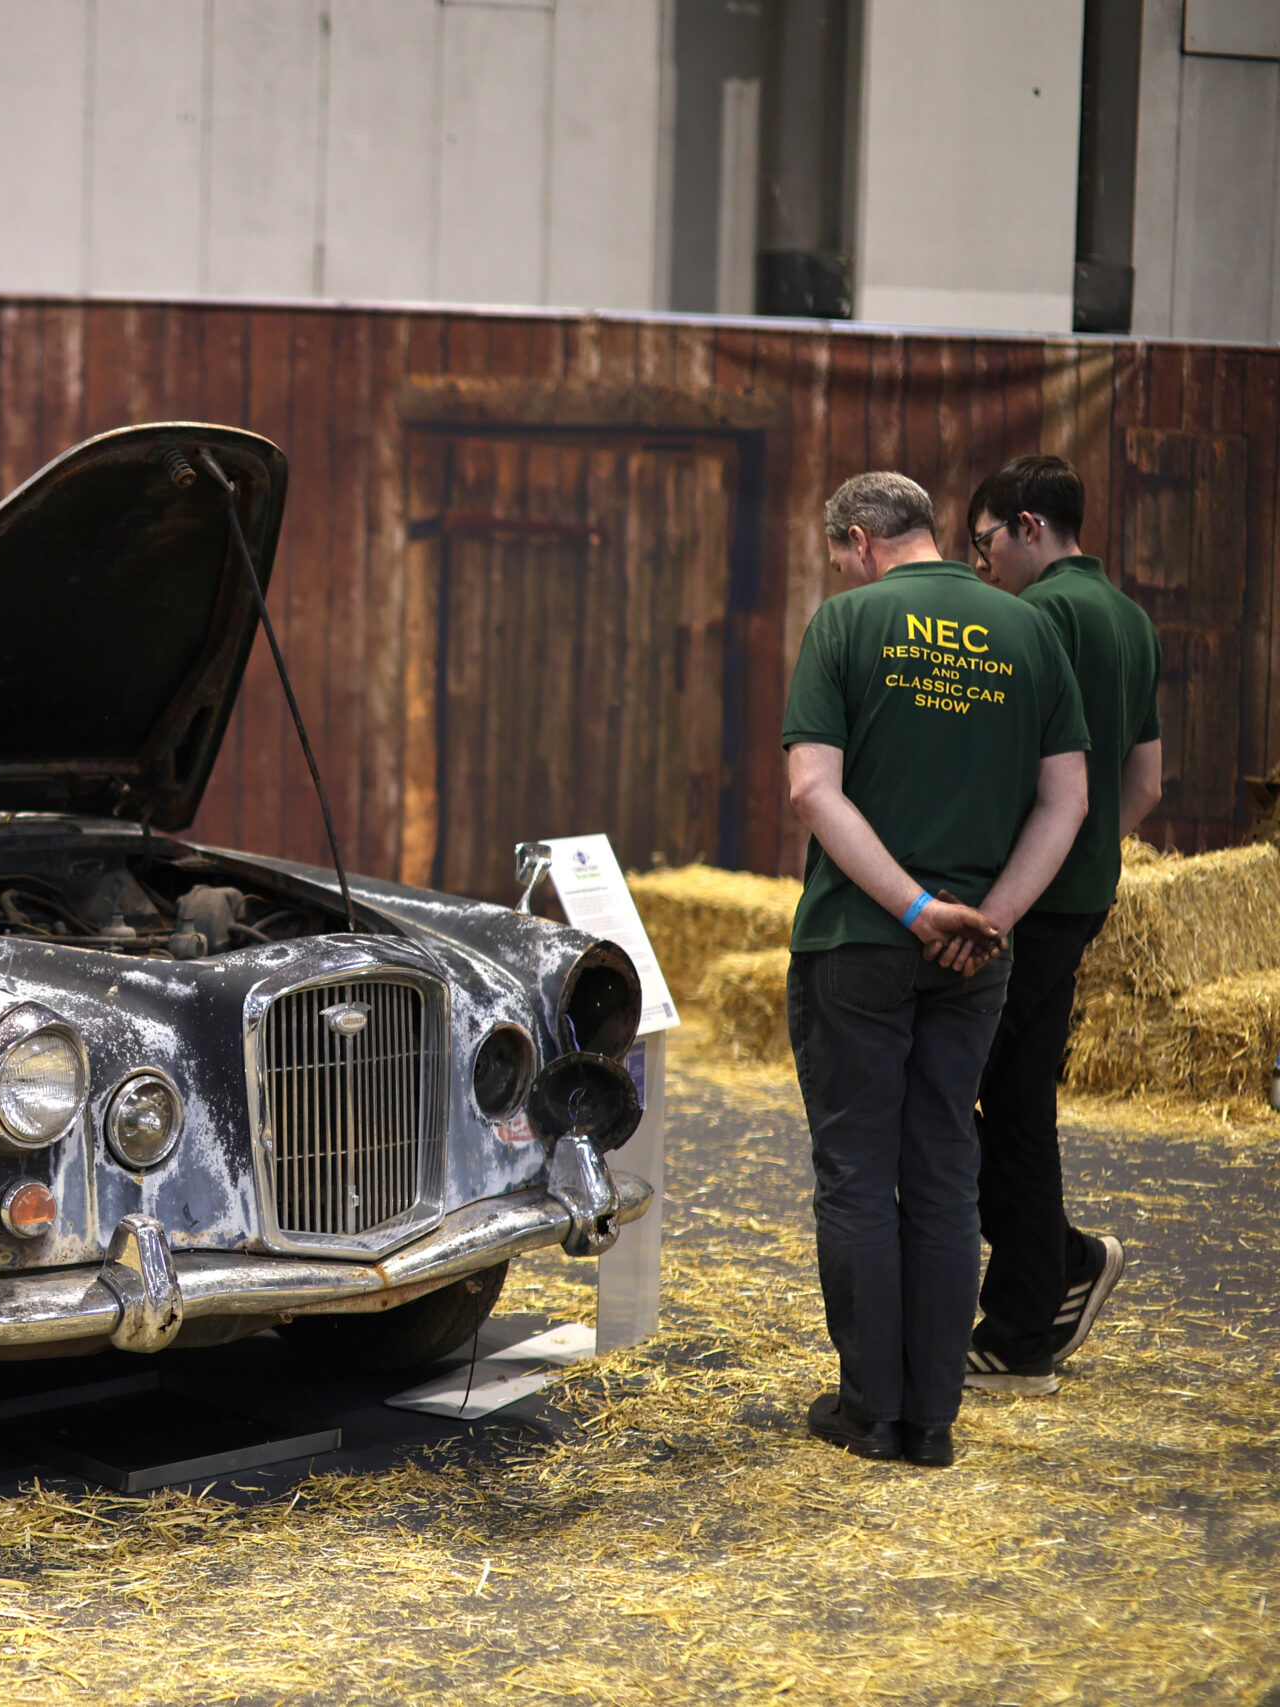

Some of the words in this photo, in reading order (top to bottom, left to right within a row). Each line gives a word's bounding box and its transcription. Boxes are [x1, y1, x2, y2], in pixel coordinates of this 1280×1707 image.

[906, 613, 990, 653] NEC
[882, 645, 1013, 675] RESTORATION
[931, 667, 960, 680] AND
[885, 674, 963, 696] CLASSIC
[966, 686, 1005, 704] CAR
[914, 693, 971, 714] SHOW
